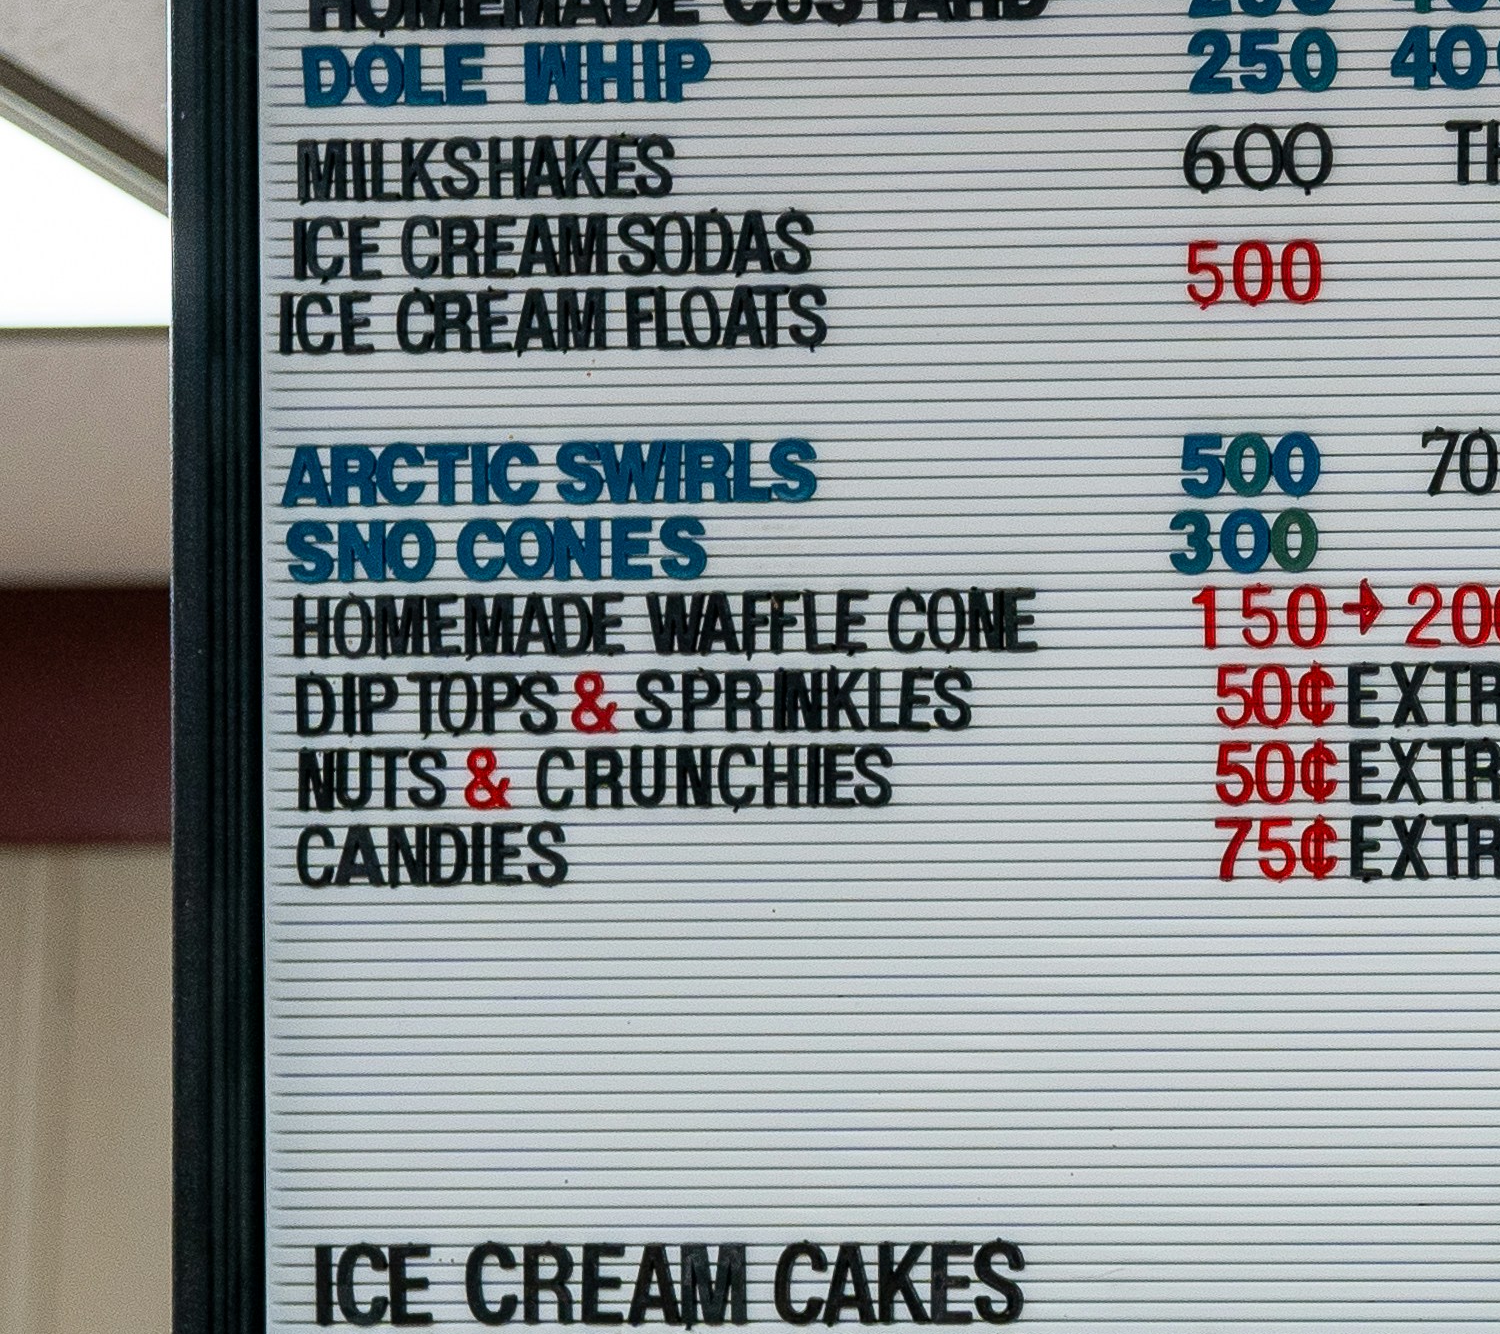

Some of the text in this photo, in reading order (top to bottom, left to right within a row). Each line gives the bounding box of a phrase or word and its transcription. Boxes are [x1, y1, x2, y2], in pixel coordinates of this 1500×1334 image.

[302, 38, 711, 107] DOLE WHIP
[1187, 27, 1339, 95] 250
[296, 132, 676, 204] MILKSHAKES
[1183, 122, 1333, 194] 600
[293, 207, 815, 282] ICE CREAM SODAS
[1186, 238, 1323, 310] 500
[278, 284, 828, 356] ICE CREAM FLOATS
[281, 437, 818, 507] ARCTIC SWIRLS
[1181, 432, 1321, 498] 500
[286, 515, 708, 583] SNO CONES
[1170, 508, 1319, 574] 300
[292, 586, 1038, 659] HOMEMADE WAFFLE CONE
[1193, 583, 1329, 650] 150
[570, 666, 972, 734] & SPRINKLES
[298, 743, 893, 812] NUTS & CRUNCHIES
[295, 822, 569, 888] CANDIES
[314, 1238, 1025, 1330] ICE CREAM CAKES
